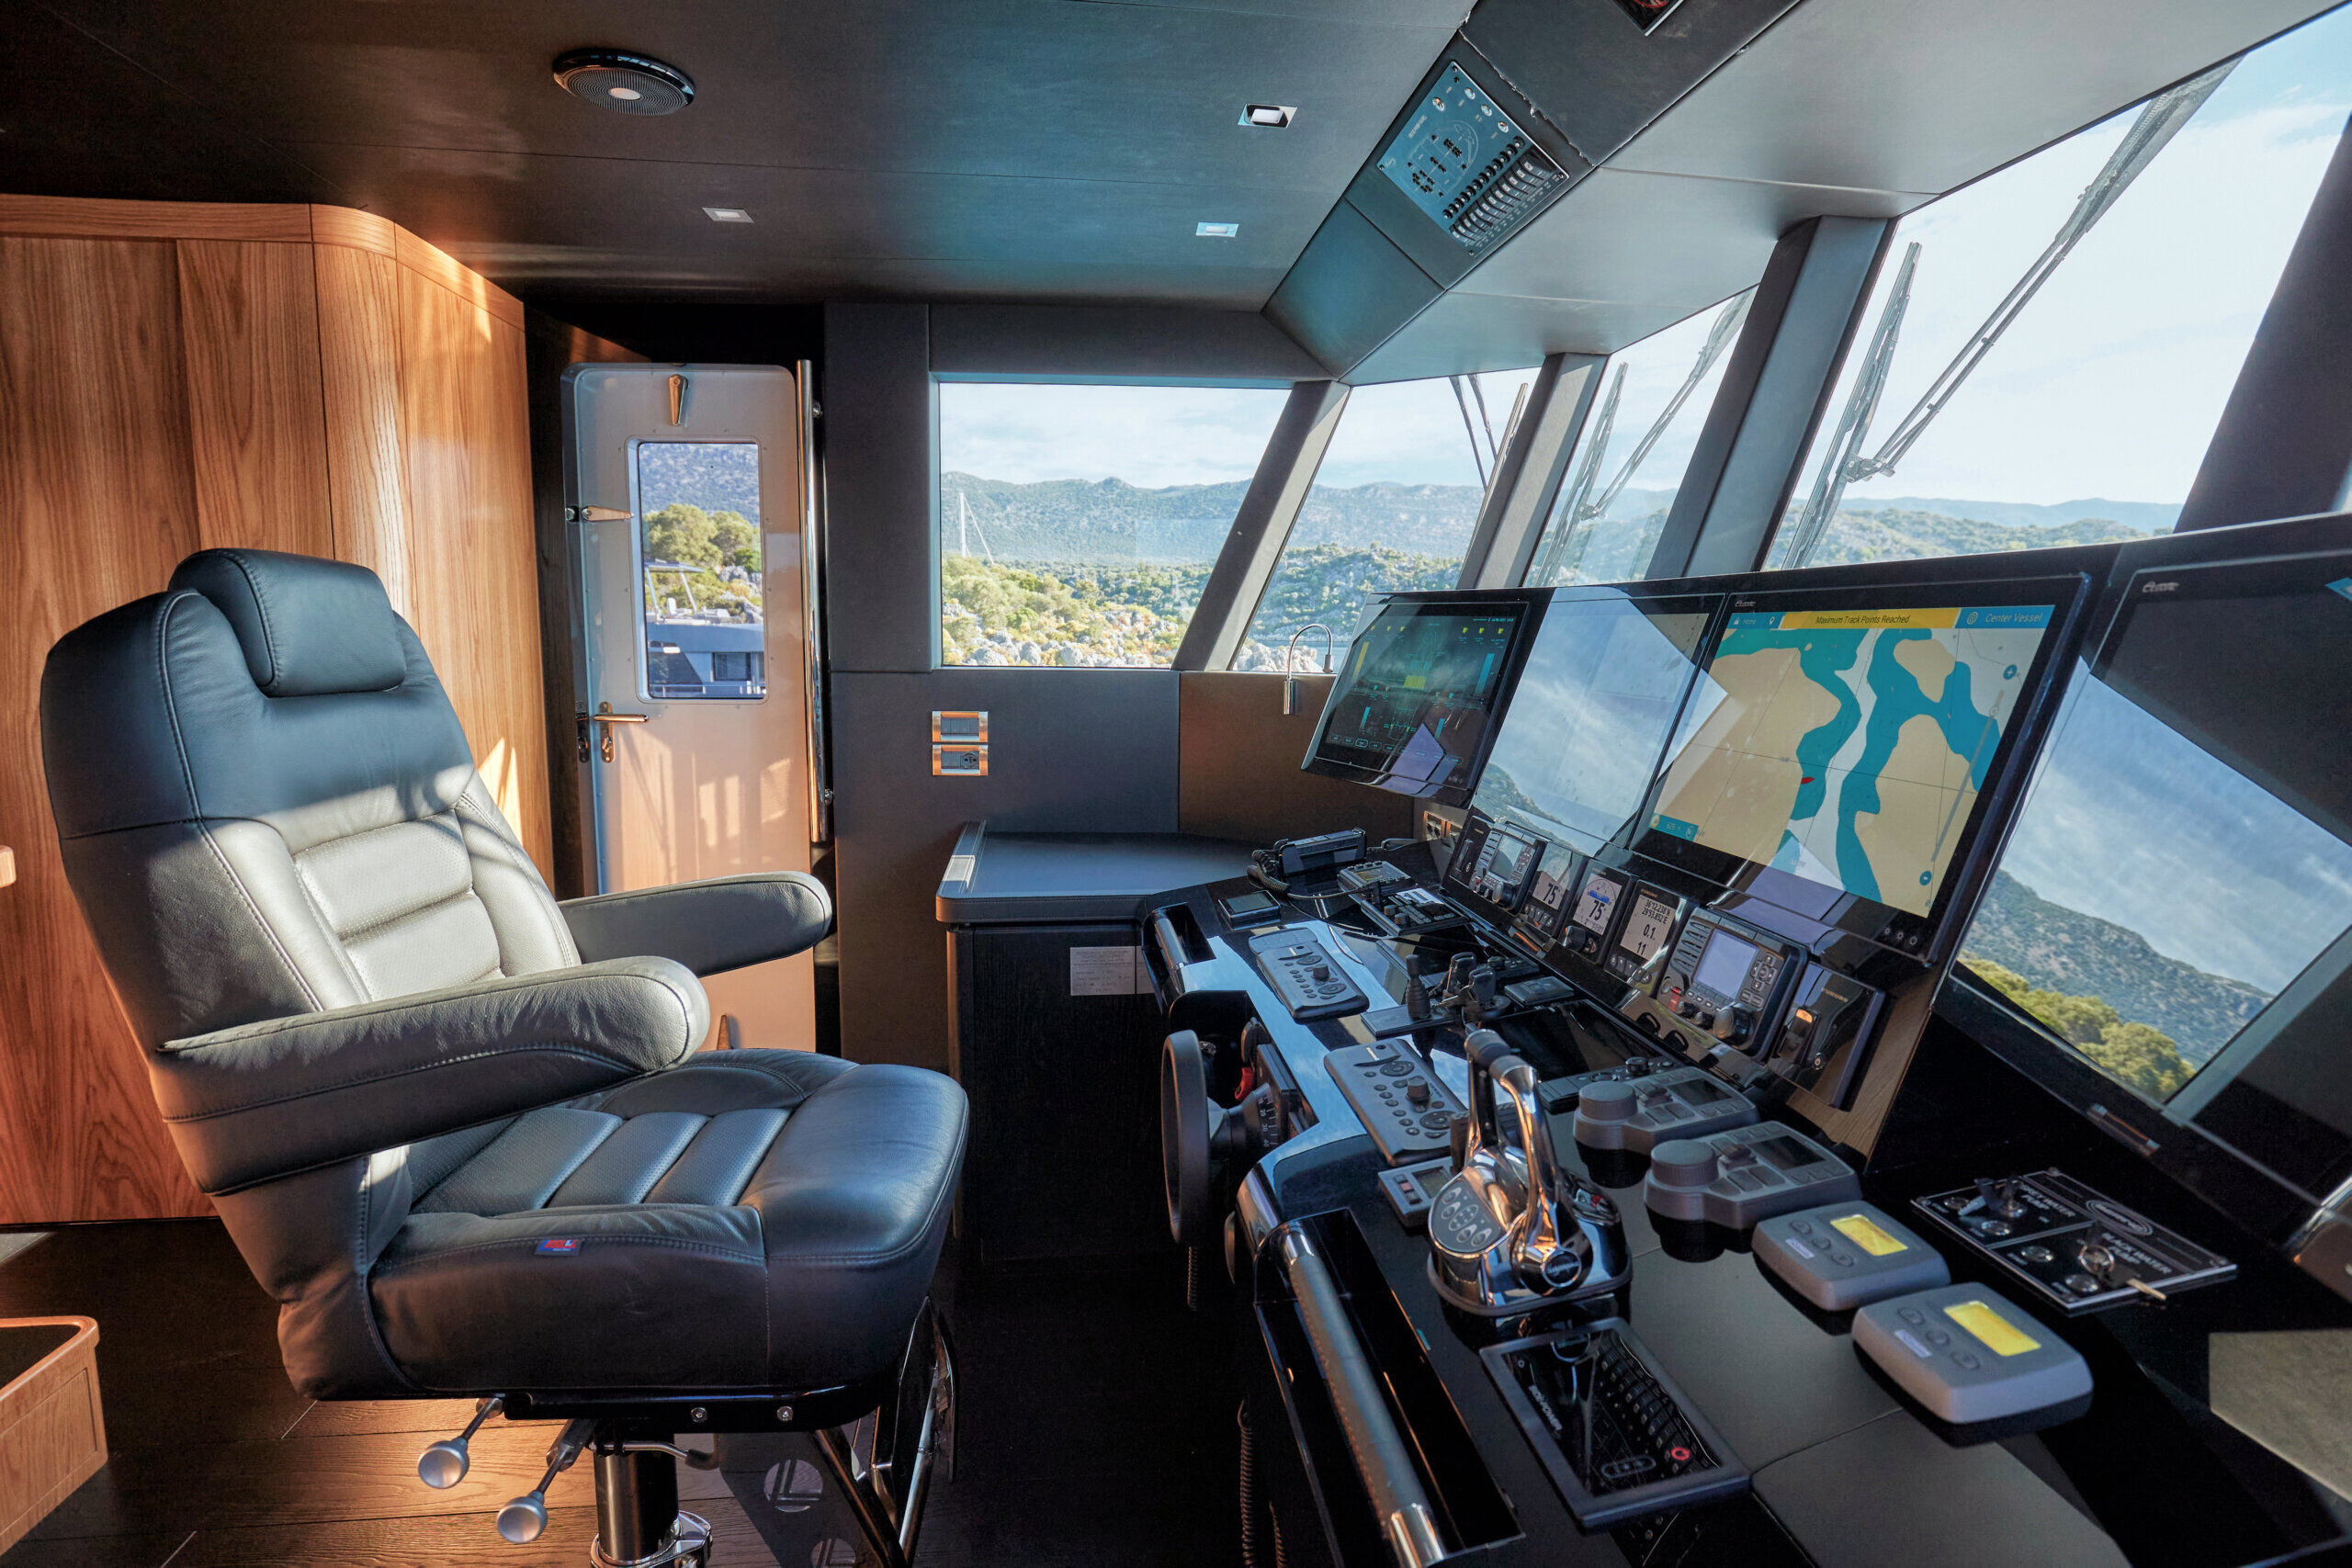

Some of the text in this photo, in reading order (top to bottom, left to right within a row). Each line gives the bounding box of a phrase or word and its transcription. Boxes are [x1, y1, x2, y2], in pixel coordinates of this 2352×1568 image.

[1815, 615, 1911, 625] Maximum Track Points Reached
[1984, 612, 2043, 623] Center Vessel
